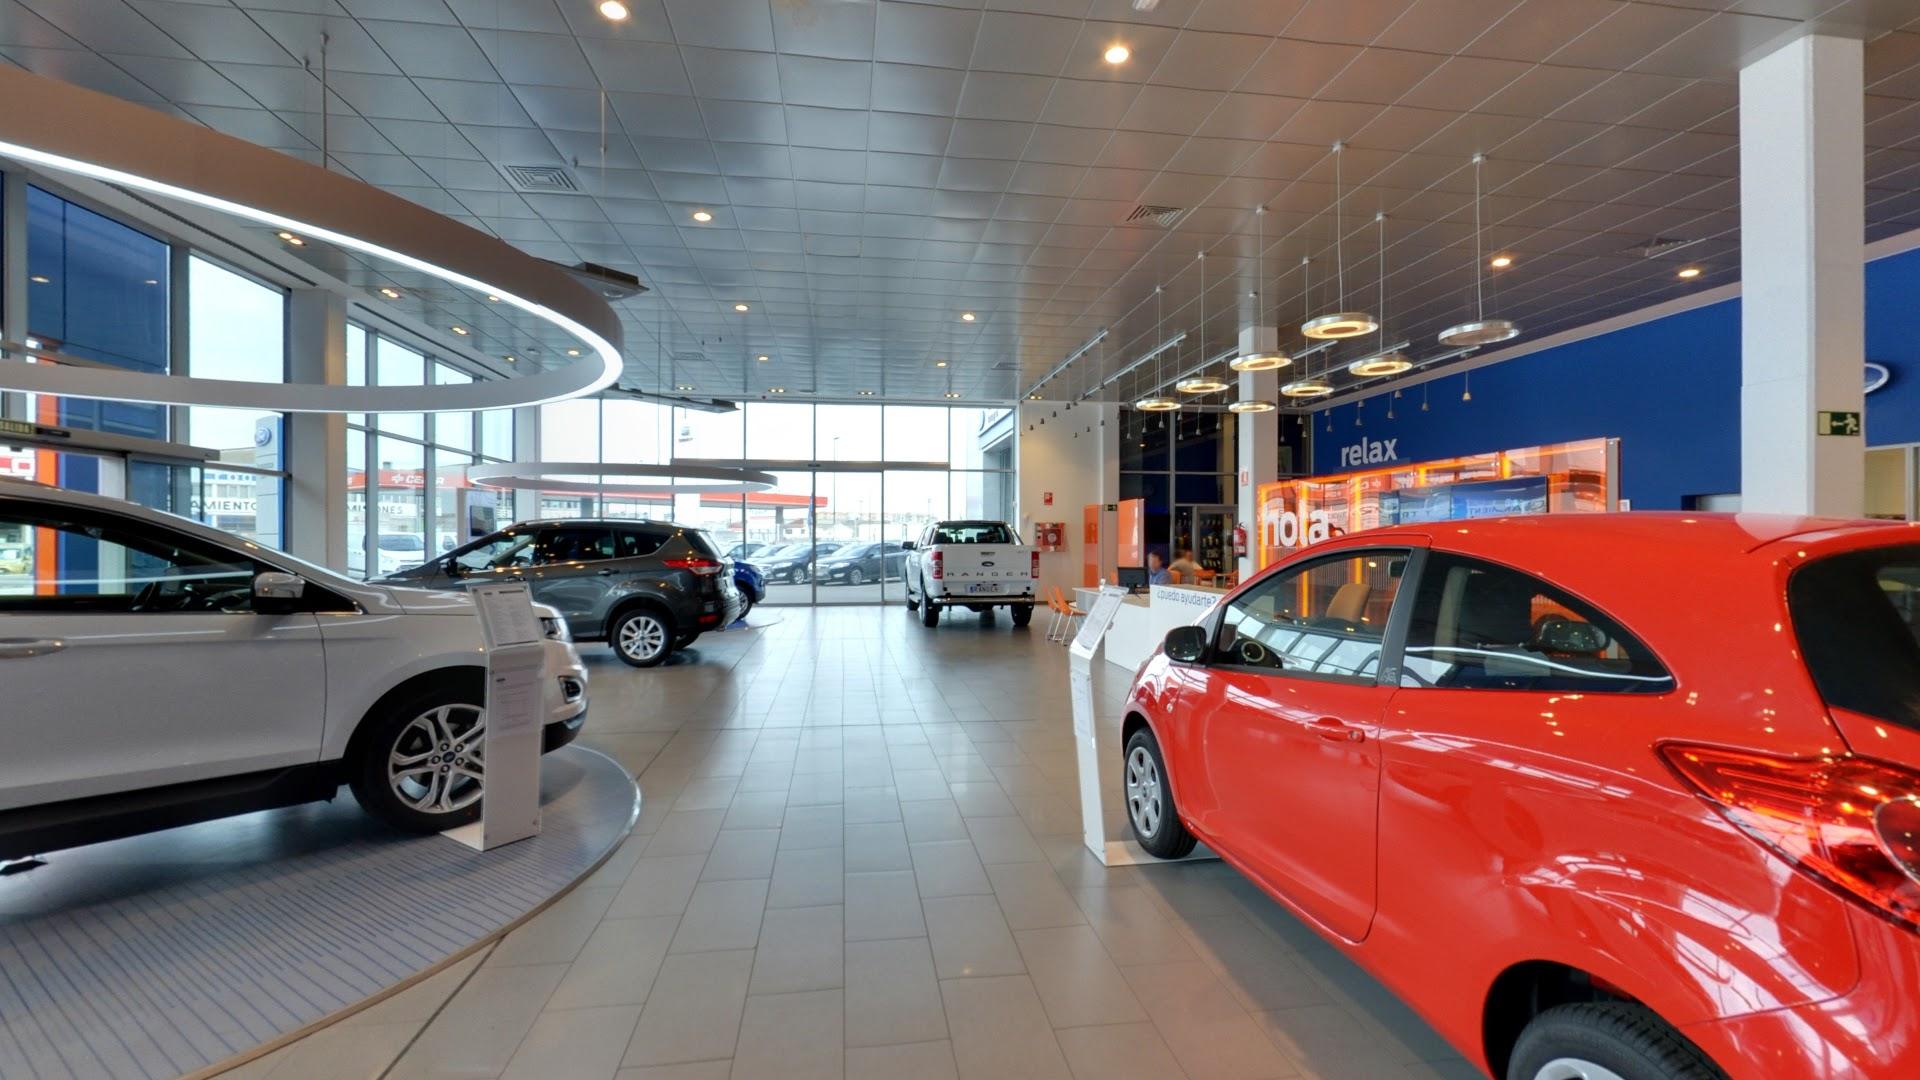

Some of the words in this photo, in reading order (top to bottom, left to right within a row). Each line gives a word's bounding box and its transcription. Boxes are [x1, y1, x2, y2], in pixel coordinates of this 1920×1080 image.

[1341, 436, 1398, 468] relax
[1263, 497, 1330, 547] hola
[1157, 590, 1180, 602] ¿puedo
[1180, 592, 1217, 607] ayudarte?
